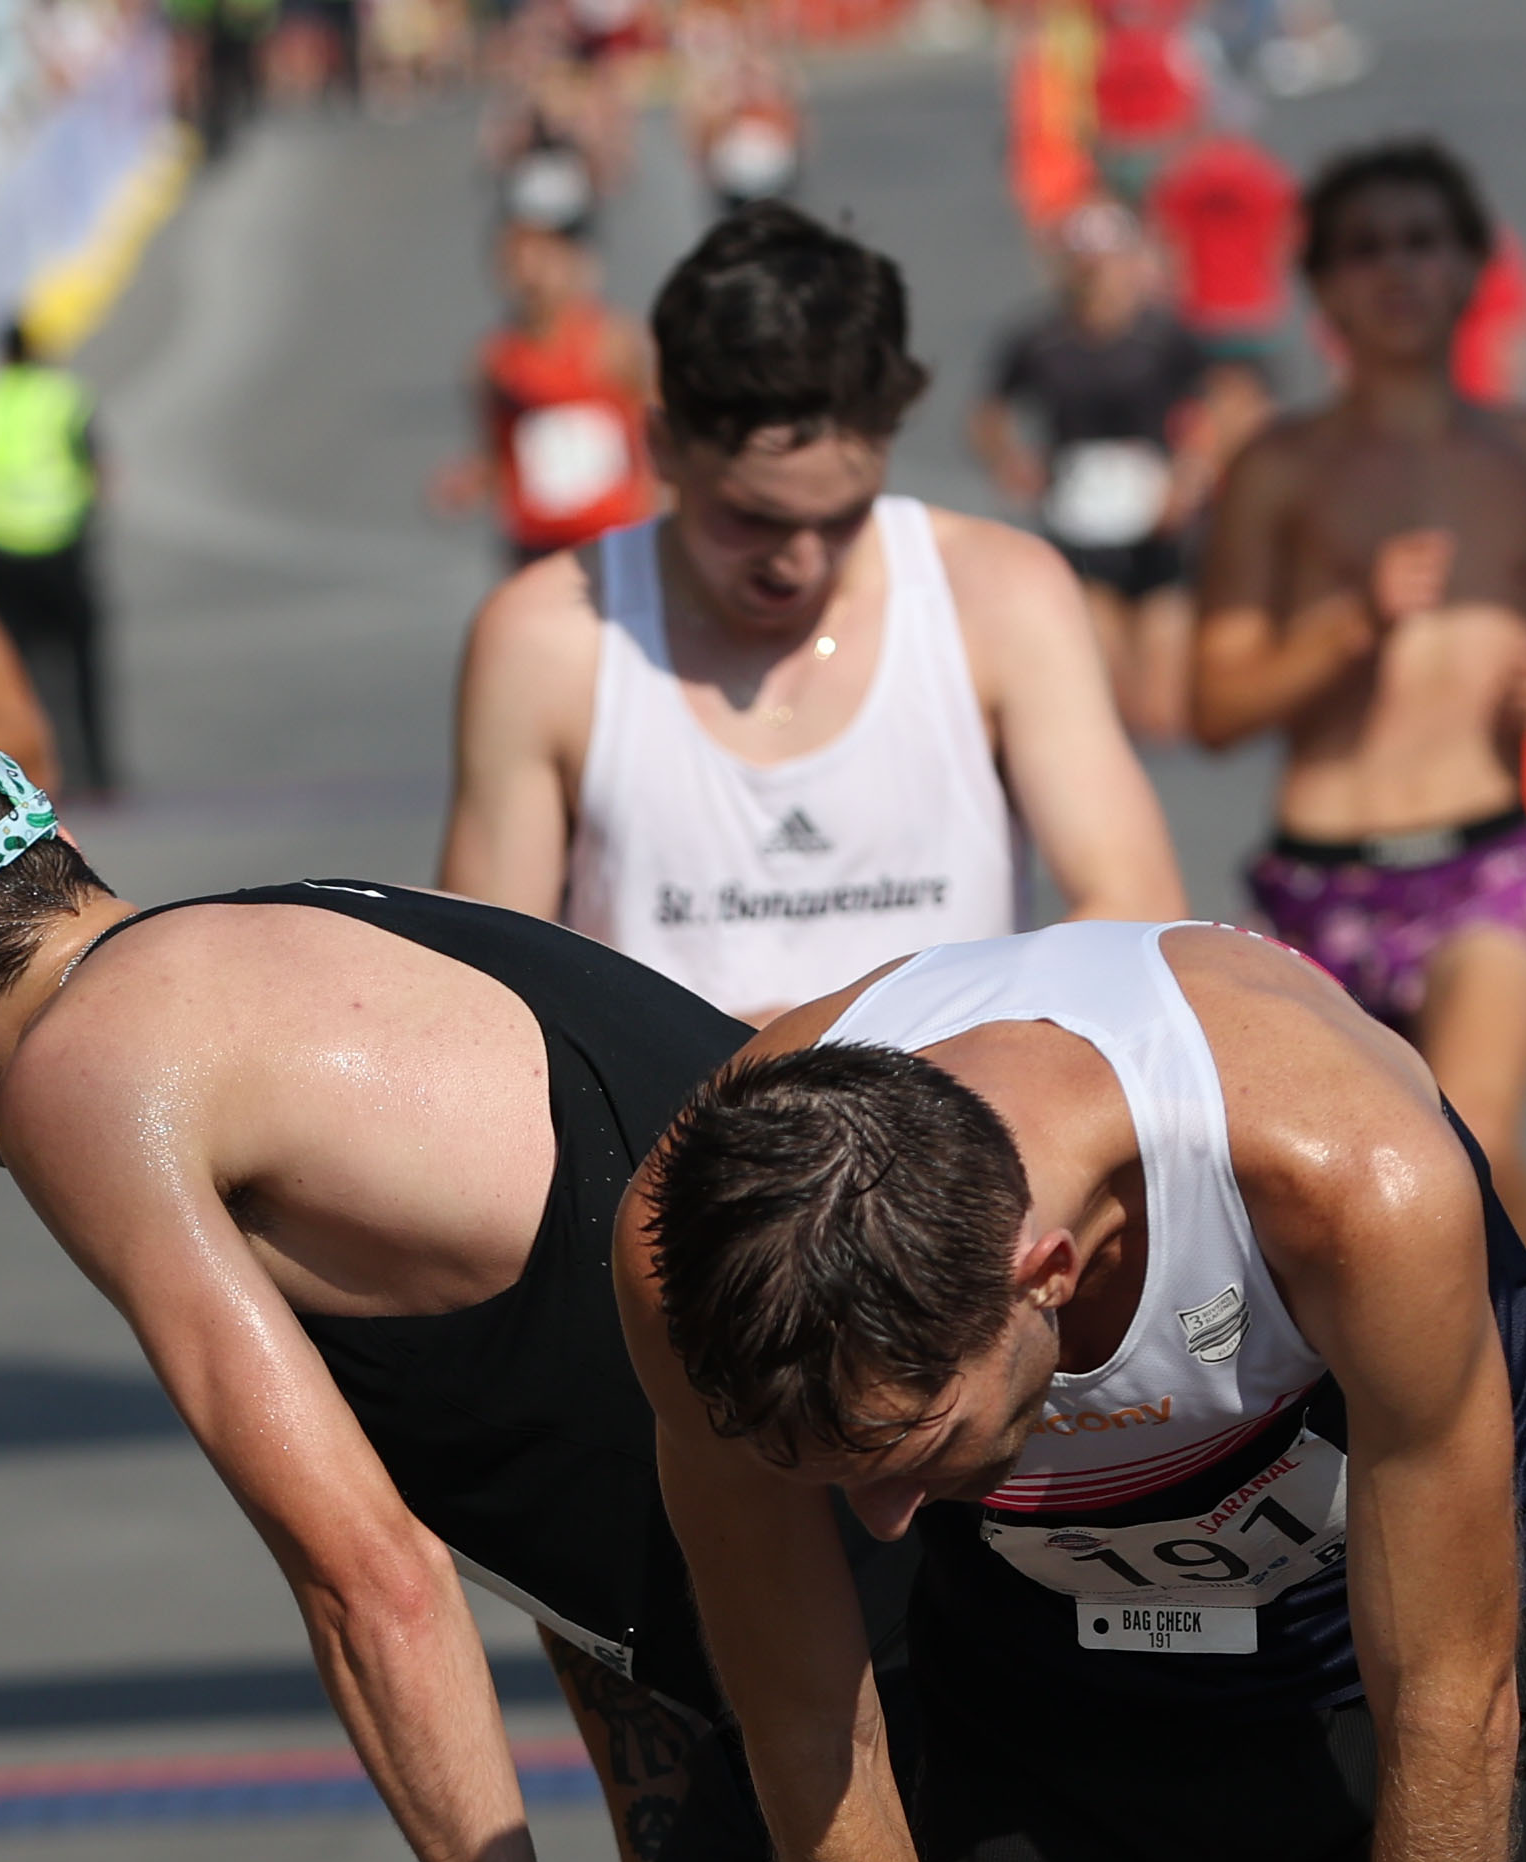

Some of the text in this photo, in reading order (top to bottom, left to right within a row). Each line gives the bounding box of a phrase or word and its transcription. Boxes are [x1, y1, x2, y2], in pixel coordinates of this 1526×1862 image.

[719, 873, 951, 921] Bonaventure
[1188, 1314, 1204, 1330] 3
[1071, 1496, 1317, 1588] 191
[1123, 1610, 1202, 1633] BAG CHECK
[1148, 1632, 1172, 1649] 191
